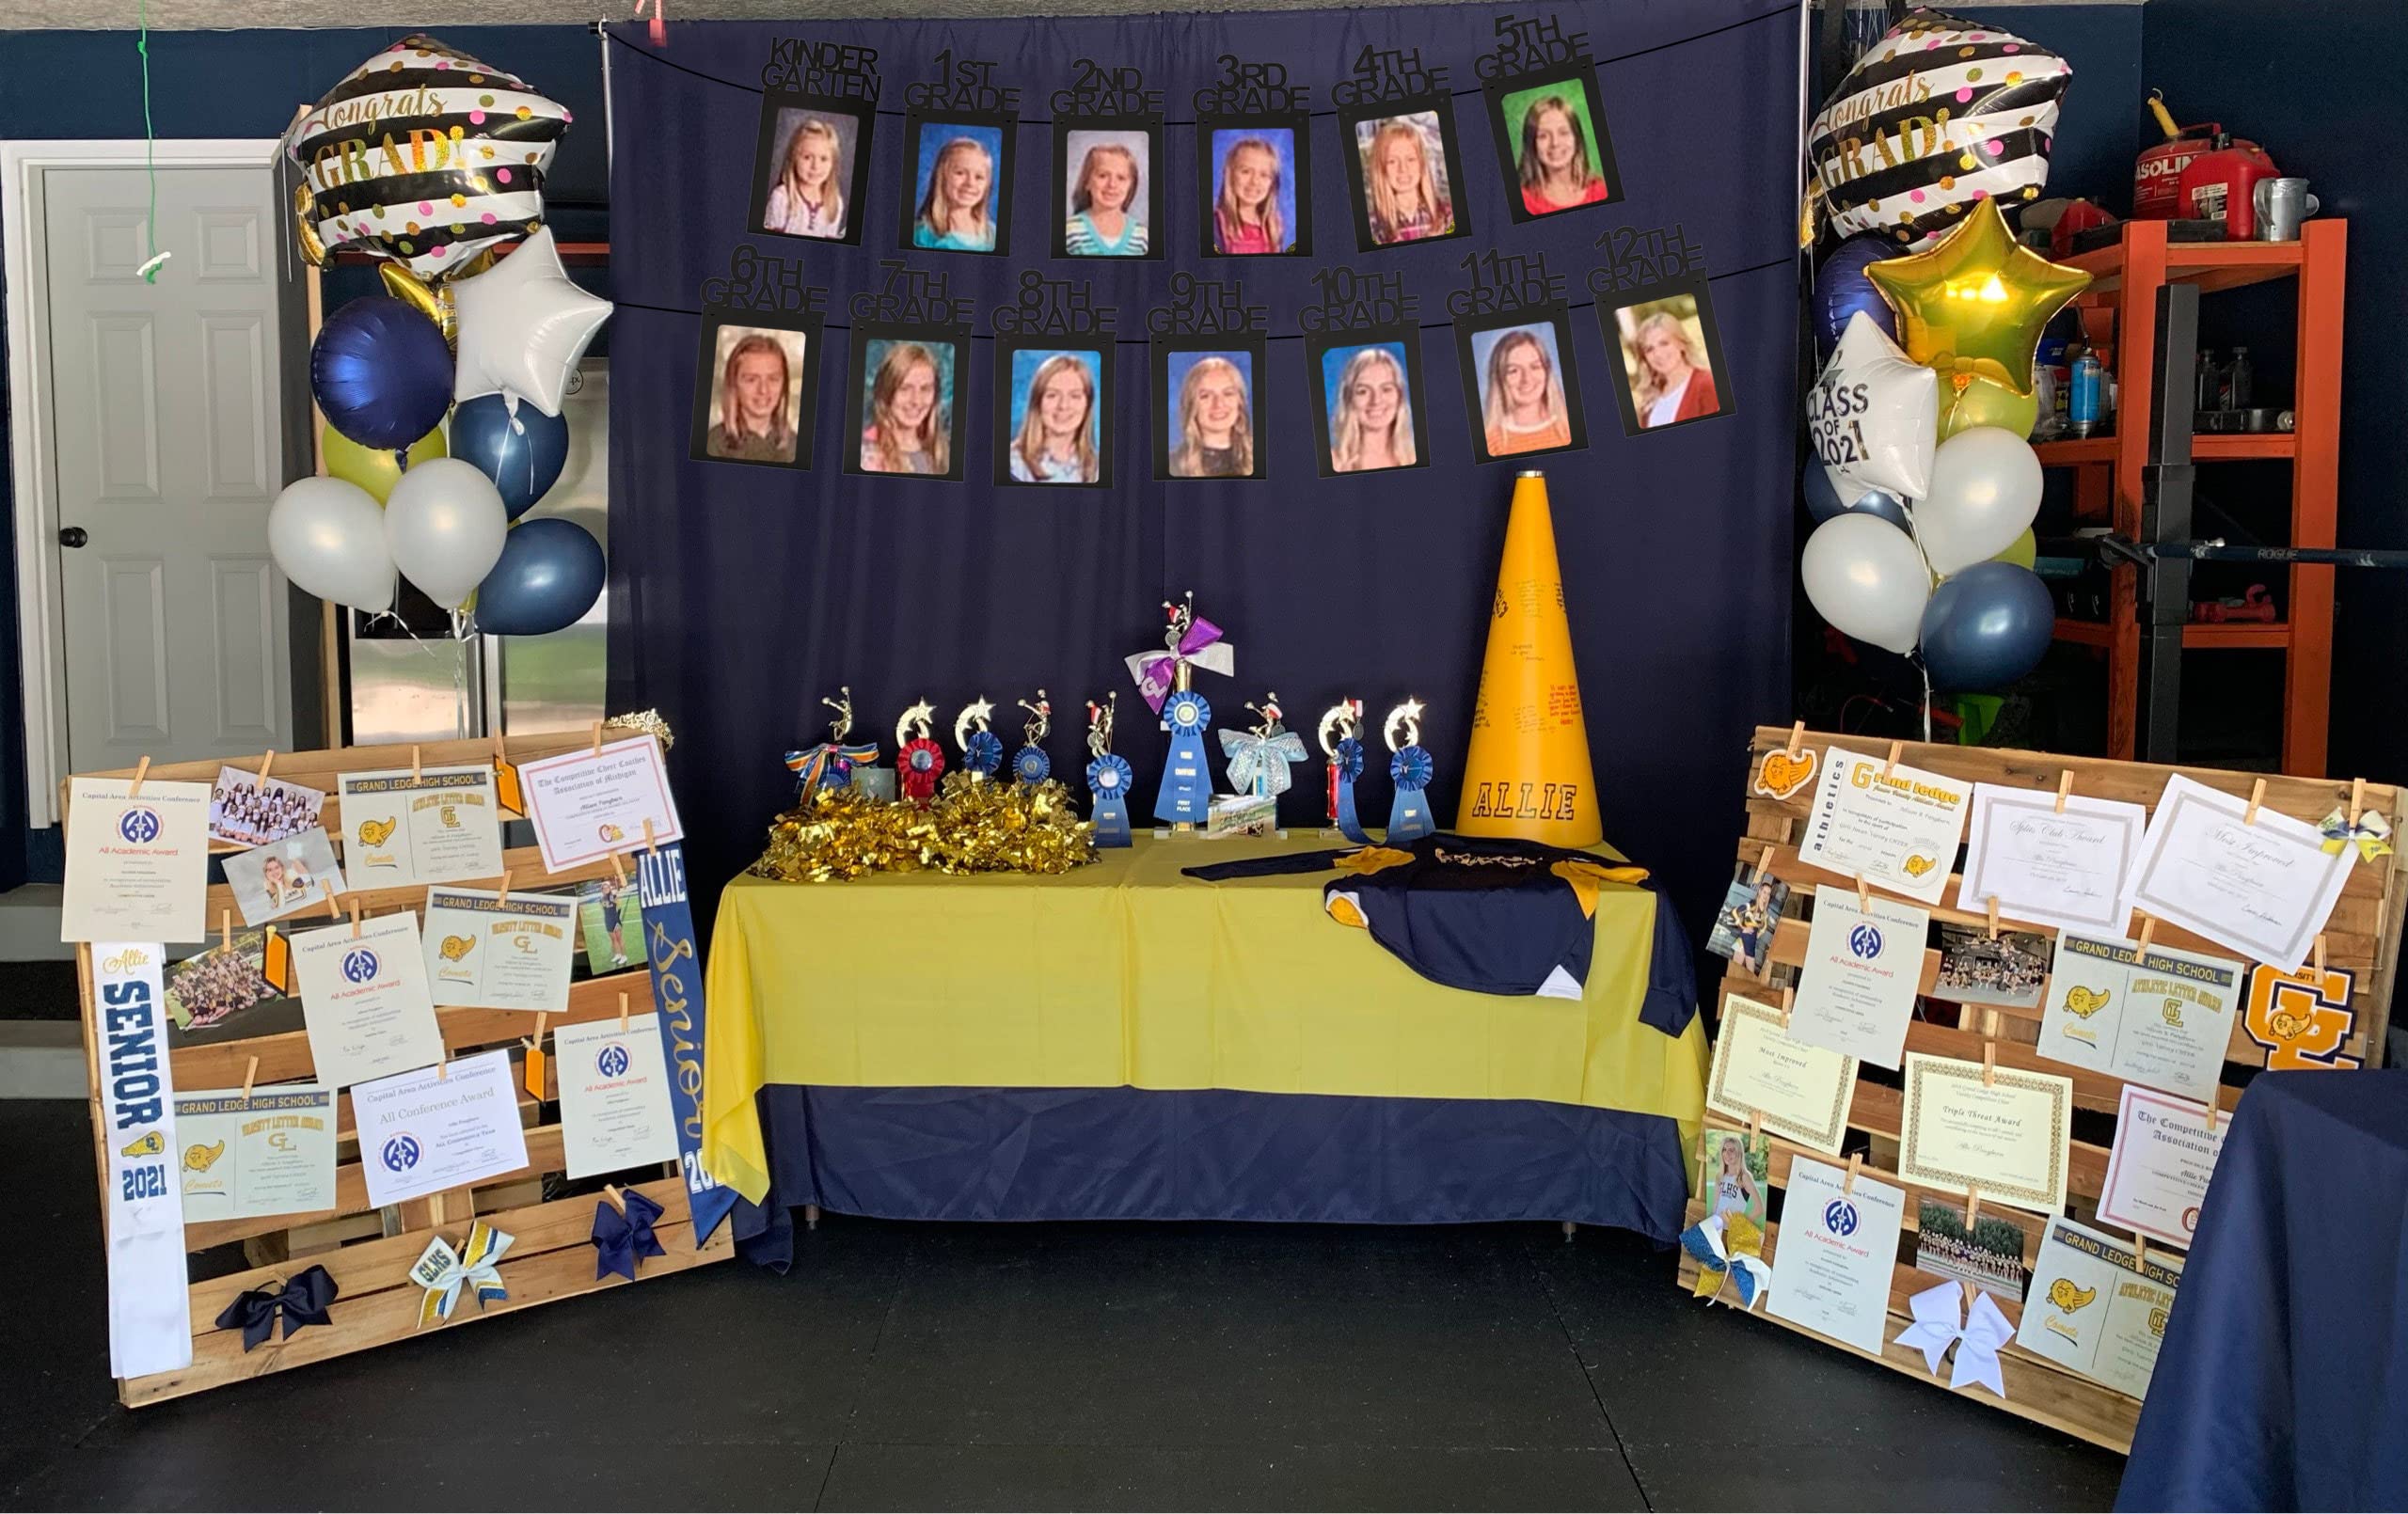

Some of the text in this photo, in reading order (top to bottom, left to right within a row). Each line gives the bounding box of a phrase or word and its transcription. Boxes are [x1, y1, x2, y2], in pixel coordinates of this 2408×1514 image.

[1495, 14, 1561, 52] 5TH
[769, 37, 879, 75] KINDER
[933, 49, 998, 88] 1ST
[1216, 54, 1287, 90] 3RD
[1353, 44, 1420, 79] 4TH
[1474, 32, 1592, 82] GRADE
[760, 62, 881, 102] GARTEN
[1071, 58, 1143, 92] 2ND
[1331, 66, 1450, 109] GRADE
[300, 83, 448, 136] Congrats
[904, 82, 1021, 113] GRADE
[1049, 89, 1164, 116] GRADE
[1192, 86, 1310, 115] GRADE
[1814, 69, 1935, 133] Congrats
[1594, 224, 1686, 268] 12TH
[730, 244, 803, 288] 6TH
[879, 260, 948, 298] 7TH
[1460, 248, 1547, 291] 11TH
[1586, 244, 1704, 297] GRADE
[700, 276, 829, 315] GRADE
[1018, 269, 1092, 309] 8TH
[1169, 271, 1242, 309] 9TH
[1310, 265, 1404, 304] 10TH
[1446, 273, 1568, 319] GRADE
[848, 292, 974, 324] GRADE
[990, 306, 1119, 334] GRADE
[1147, 305, 1270, 335] GRADE
[1299, 294, 1419, 335] GRADE
[1807, 384, 1868, 422] CLASS
[1812, 420, 1870, 466] 2021
[1824, 419, 1840, 436] OF
[2258, 548, 2297, 560] ROGUE
[1141, 677, 1167, 698] GL
[356, 781, 387, 792] GRAND
[389, 779, 418, 790] LEDGE
[443, 775, 477, 785] SCHOOL
[1471, 782, 1576, 820] ALLIE
[1913, 781, 1960, 805] ledge
[1814, 761, 1844, 852] athletics
[111, 847, 150, 856] Academic
[640, 848, 687, 909] ALLIE
[442, 897, 558, 915] GRAND LEDGE HIGH SCHOOL
[1823, 900, 1919, 928] Capital Area Conference
[103, 948, 150, 975] Allie
[302, 943, 325, 953] Capital
[327, 938, 341, 947] Area
[2076, 940, 2219, 983] GRAND HIGH SCHOOL
[1840, 958, 1871, 971] Academic
[1872, 968, 1894, 978] Award
[341, 986, 376, 999] Academic
[377, 980, 401, 989] Award
[103, 980, 164, 1129] SENIOR
[586, 1034, 599, 1043] Area
[1759, 1047, 1808, 1068] Most Improved
[368, 1089, 396, 1103] Capital
[398, 1085, 417, 1096] Area
[455, 1066, 496, 1081] Conference
[594, 1080, 626, 1091] Academic
[182, 1095, 316, 1113] GRAND LEDGE HIGH SCHOOL
[380, 1087, 495, 1125] All Conference Award
[1942, 1105, 2022, 1128] Triple Threat Award
[2138, 1110, 2218, 1143] The Competitive
[2153, 1129, 2210, 1155] Association
[122, 1164, 167, 1202] 2021
[1798, 1172, 1895, 1208] Capital Area Conference
[1805, 1229, 1870, 1257] All Academic Award
[2065, 1232, 2100, 1254] GRAND
[2101, 1249, 2136, 1269] LEDGE
